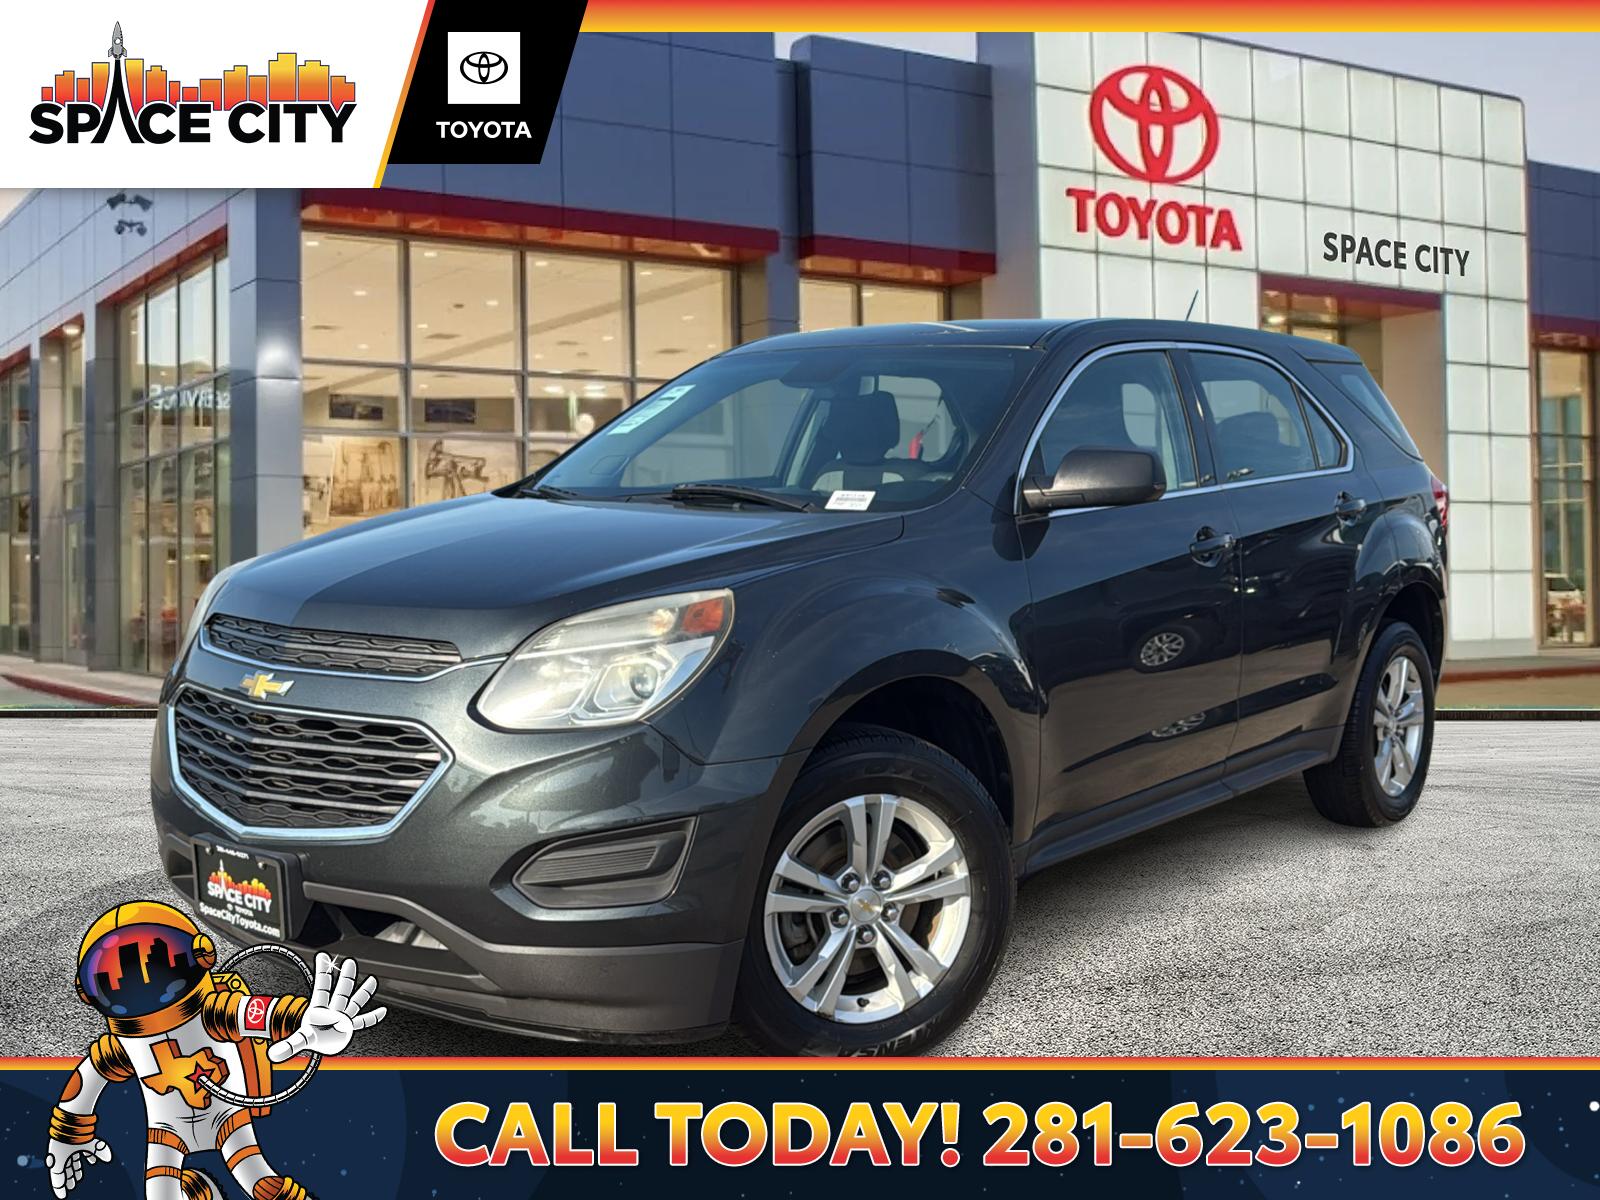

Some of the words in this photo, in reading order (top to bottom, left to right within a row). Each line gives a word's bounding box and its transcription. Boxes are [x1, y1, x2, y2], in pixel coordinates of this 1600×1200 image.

[1066, 187, 1242, 251] TOYOTA
[1323, 232, 1407, 270] SPACE
[1414, 244, 1470, 277] CITY
[207, 871, 243, 905] SPACE
[244, 893, 272, 913] CITY
